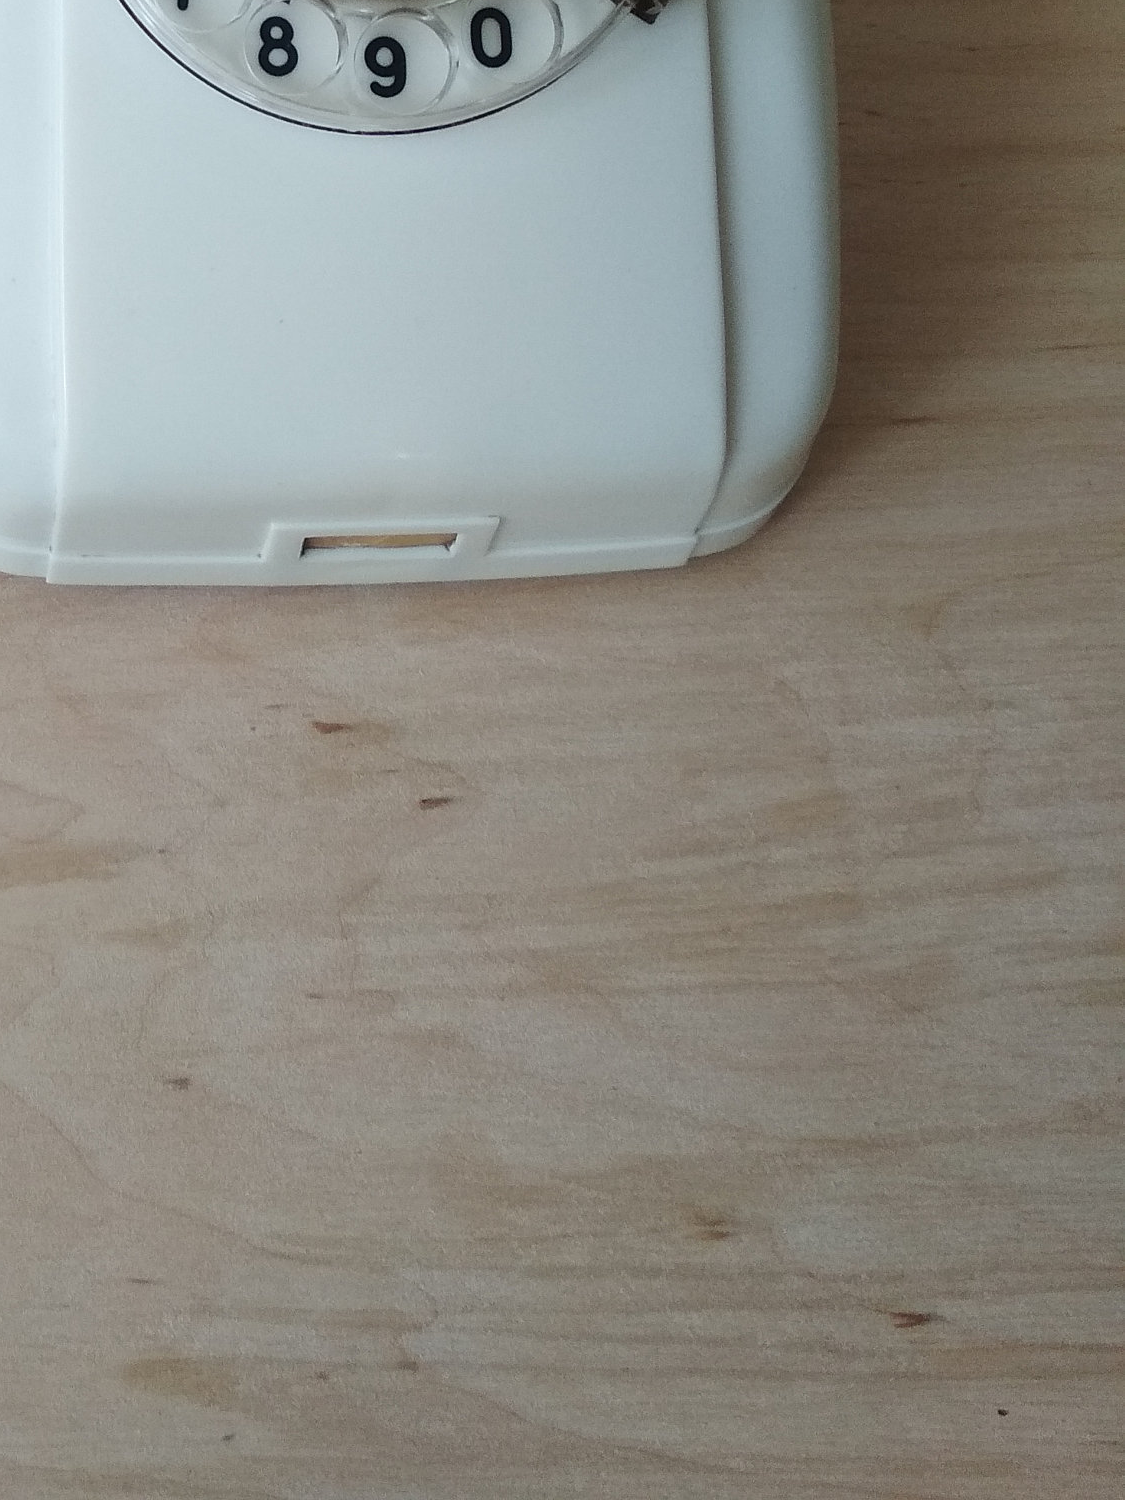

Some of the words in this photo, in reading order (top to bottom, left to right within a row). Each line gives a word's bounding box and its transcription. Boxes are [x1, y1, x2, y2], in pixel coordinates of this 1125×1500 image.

[257, 15, 299, 78] 8
[363, 35, 408, 99] 9
[469, 3, 513, 69] 0
